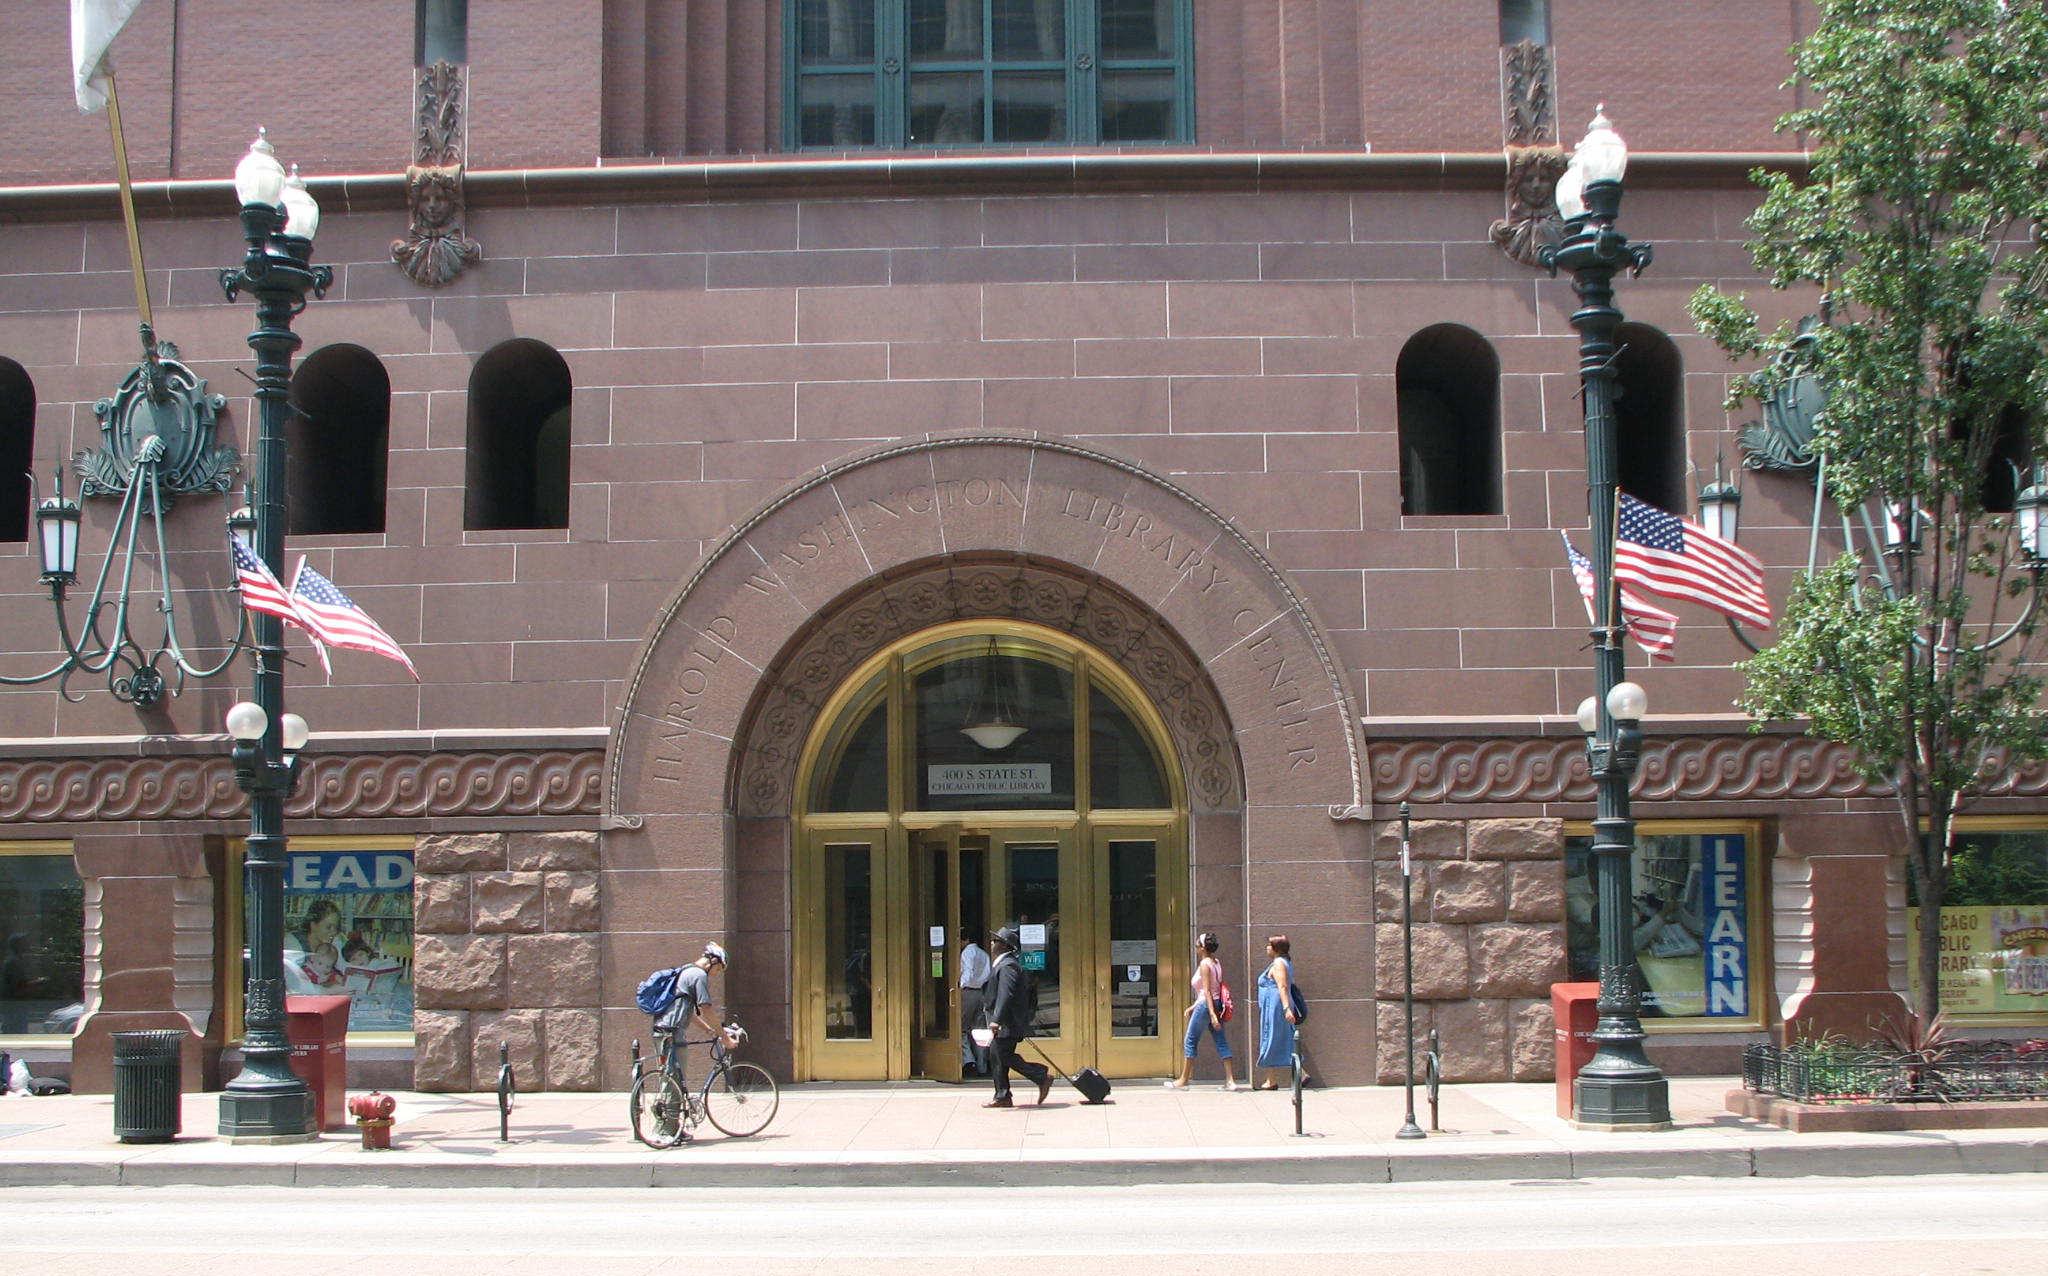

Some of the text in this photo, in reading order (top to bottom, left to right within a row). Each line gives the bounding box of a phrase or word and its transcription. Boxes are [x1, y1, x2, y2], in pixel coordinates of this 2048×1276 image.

[653, 478, 1319, 783] HAROLD WASHINGTON LIBRARY CENTER
[931, 780, 1048, 792] CHICAGO PUBLIC LIBRARY
[943, 769, 963, 780] 400
[979, 768, 1018, 780] STATE
[284, 855, 416, 889] EAD
[1709, 839, 1745, 1014] LEARN
[1914, 914, 1979, 932] CCAGO
